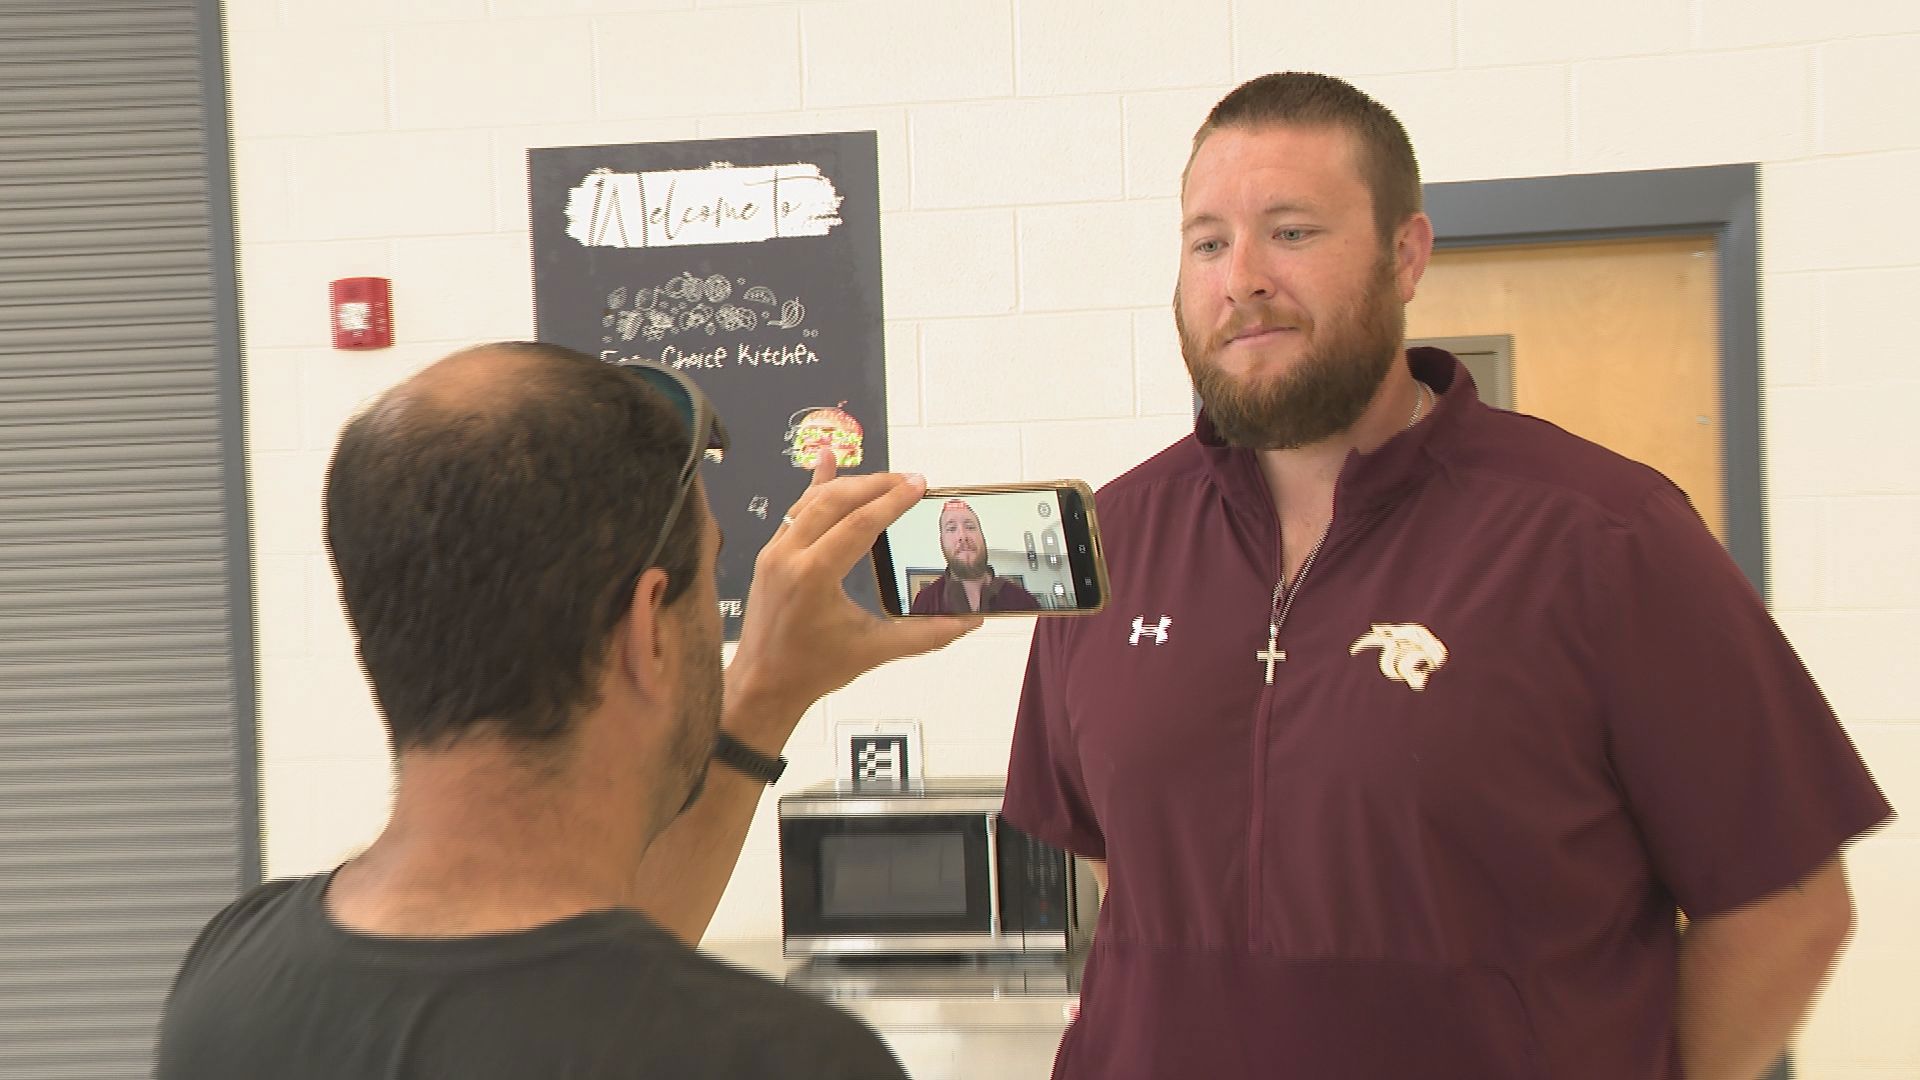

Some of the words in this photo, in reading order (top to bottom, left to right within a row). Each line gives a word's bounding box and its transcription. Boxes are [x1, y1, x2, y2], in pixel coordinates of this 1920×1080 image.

[587, 171, 761, 248] Welcome
[660, 345, 728, 370] Choice
[738, 342, 819, 367] Kitchen
